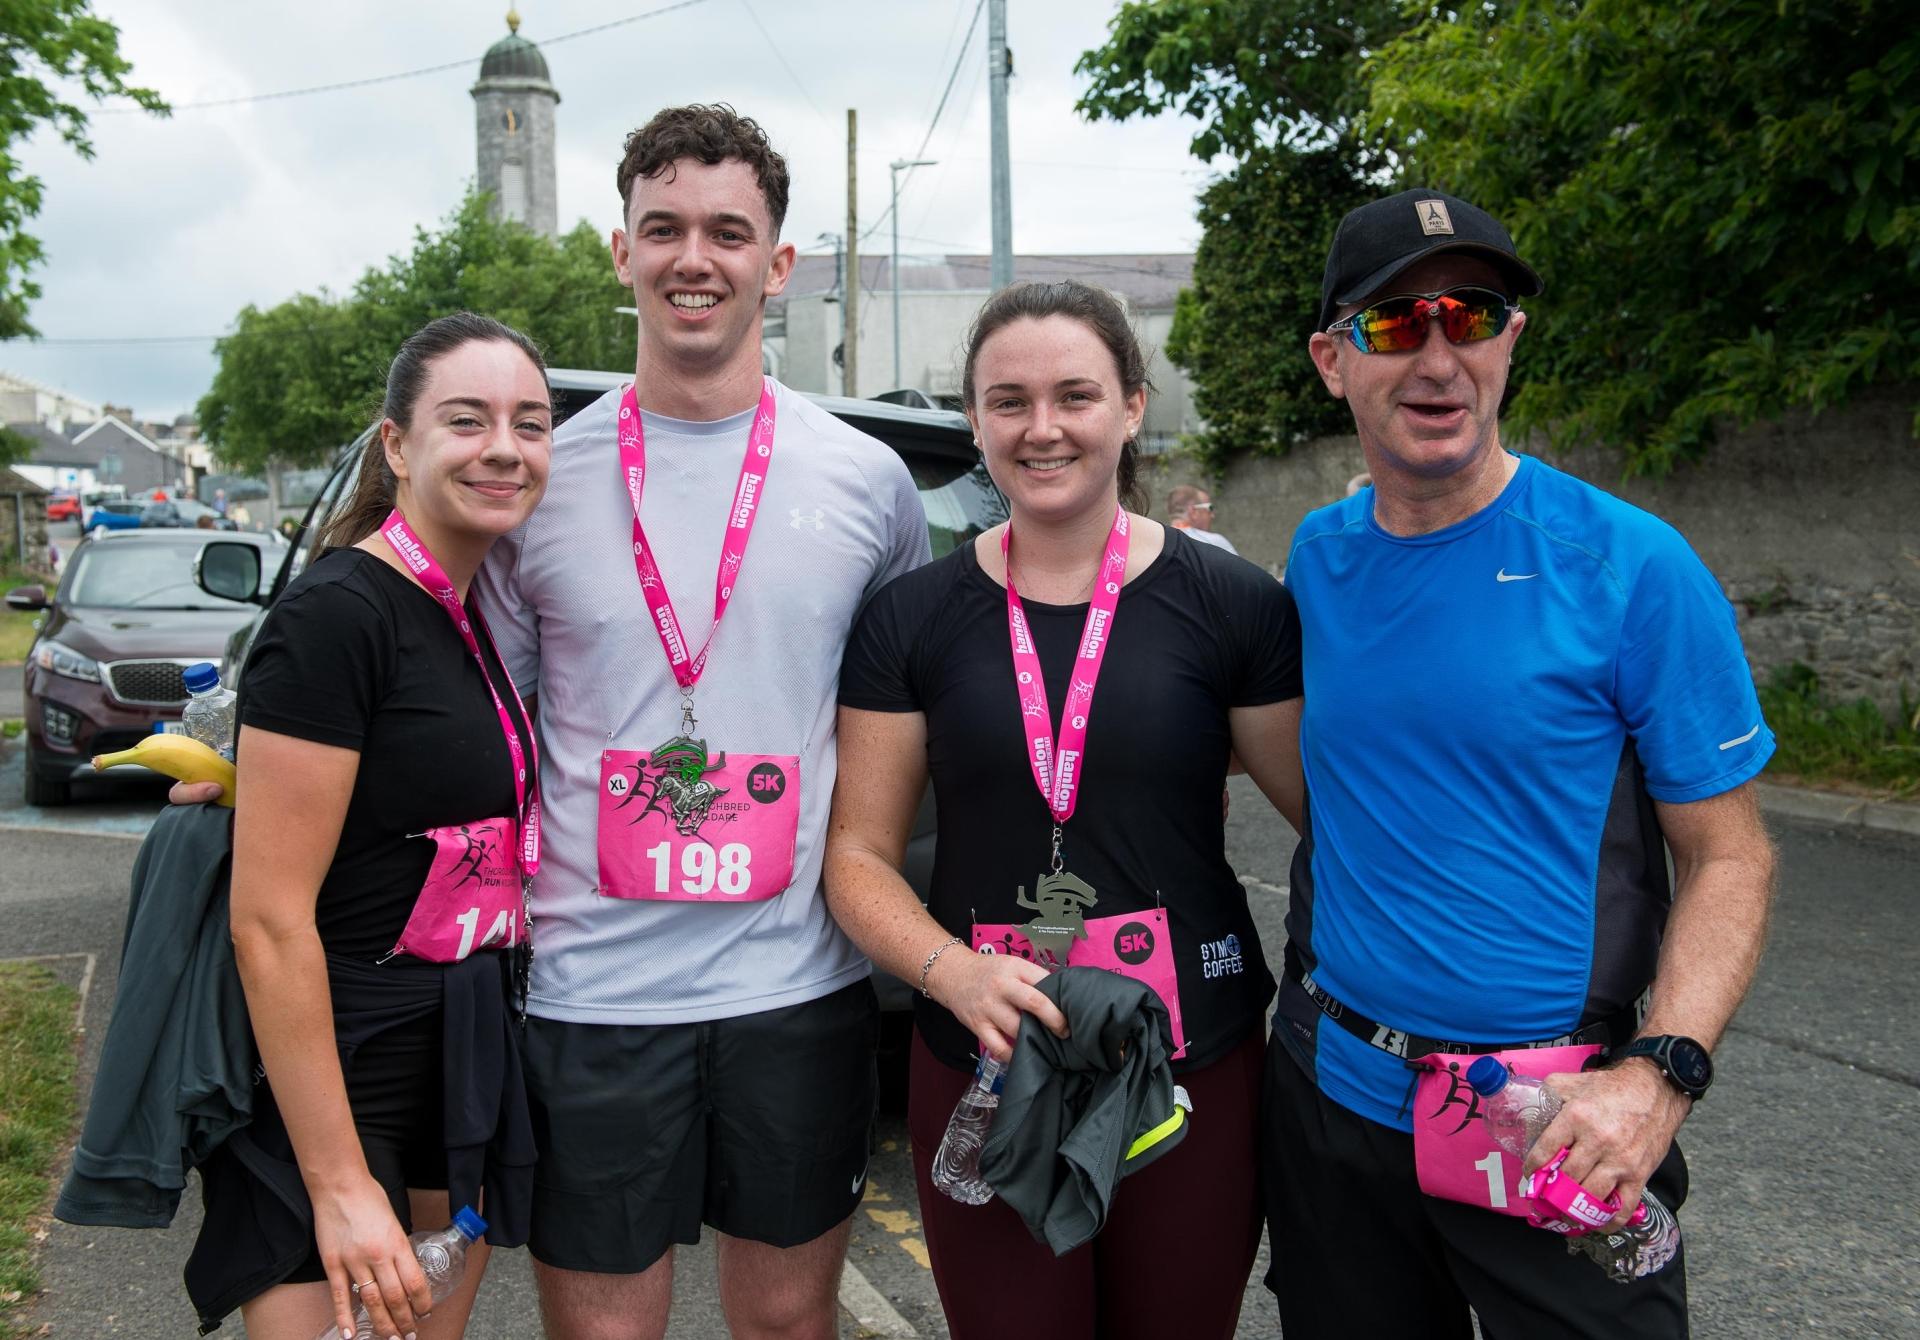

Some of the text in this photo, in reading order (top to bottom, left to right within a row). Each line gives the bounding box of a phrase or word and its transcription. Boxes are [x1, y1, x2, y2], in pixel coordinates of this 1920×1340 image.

[737, 473, 762, 528] hanlon
[389, 521, 430, 572] hanlon
[656, 606, 684, 665] hanlon
[1012, 605, 1029, 654] hanlon
[1086, 609, 1111, 659] hanlon
[610, 779, 626, 791] XL
[752, 773, 781, 792] 5K
[1058, 750, 1080, 812] hanlon
[646, 841, 752, 895] 198
[1120, 932, 1148, 953] 5K
[1201, 942, 1228, 960] GYM
[1203, 955, 1244, 979] COFFEE
